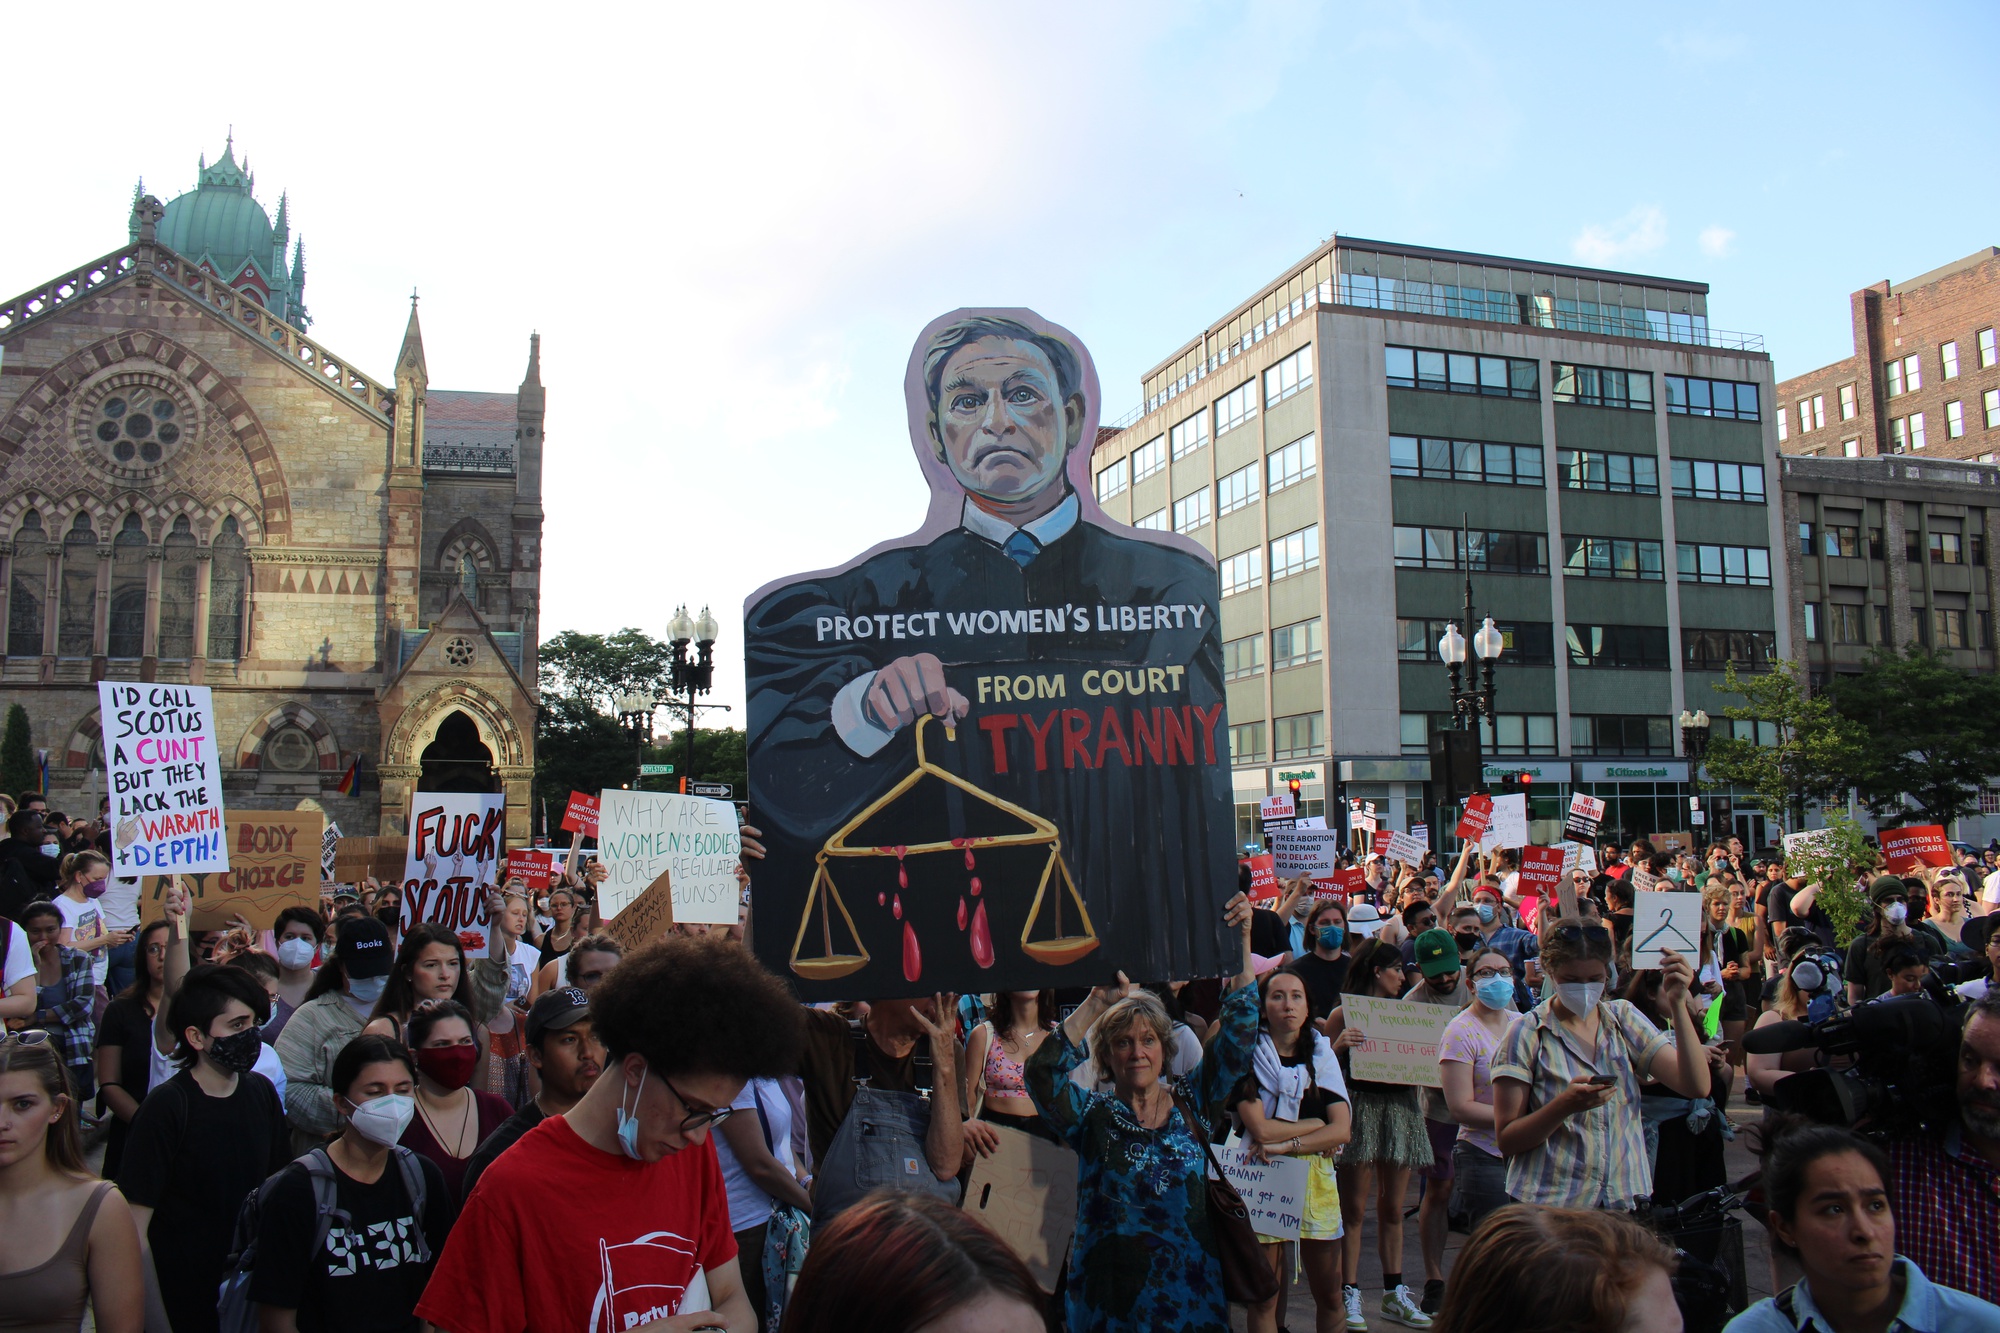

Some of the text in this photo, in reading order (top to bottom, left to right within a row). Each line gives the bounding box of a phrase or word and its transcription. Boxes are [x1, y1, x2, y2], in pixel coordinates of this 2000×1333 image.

[816, 603, 1206, 641] PROTECT WOMEN'S LIBERTY
[977, 665, 1184, 703] FROM COURT
[112, 686, 196, 708] I'D CALL
[116, 708, 203, 739] SCOTUS
[979, 703, 1223, 774] TYRANNY
[113, 735, 206, 767] A CUNT
[113, 761, 206, 794] BUT THEY
[1614, 767, 1668, 777] Citizens Bank
[119, 786, 209, 817] LACK THE
[569, 802, 600, 817] ABORTION
[1271, 796, 1283, 806] WE
[1583, 796, 1594, 807] WE
[567, 811, 600, 826] HEALTHCA
[612, 796, 720, 828] WHY ARE
[1263, 806, 1293, 817] DEMAND
[1571, 802, 1601, 819] DEMAND
[139, 806, 220, 843] WARMTH
[324, 826, 335, 838] THE
[236, 823, 299, 854] BODY
[415, 805, 503, 864] FUCK
[1276, 834, 1295, 842] FREE
[1296, 834, 1335, 843] ABORTION
[1405, 836, 1426, 849] ABORTION
[1886, 835, 1942, 850] ABORTION IS
[133, 831, 218, 867] DEPTH!
[601, 831, 740, 860] WOMEN'S BODIES
[1289, 844, 1322, 852] DEMAND
[1399, 840, 1418, 850] DEMAND
[1889, 844, 1945, 859] HEALTHCARE
[510, 860, 540, 870] ABORTION
[1276, 852, 1319, 861] NO DELAYS.
[509, 868, 547, 878] HEALTHCARE
[602, 856, 739, 886] MORE REGULATED
[1265, 867, 1273, 875] IS
[1289, 862, 1330, 870] APOLOGIES.
[1523, 861, 1560, 872] ABORTION IS
[218, 862, 306, 893] CHOICE
[1250, 876, 1274, 888] HCARE
[1522, 872, 1559, 883] HEALTHCARE
[1635, 871, 1648, 880] FREE
[670, 883, 731, 906] GUNS?!
[1312, 881, 1344, 892] HEALTH
[399, 876, 492, 938] SCOTUS
[608, 886, 656, 936] HAT ABOUT
[624, 900, 668, 953] RTBEAT?
[356, 939, 383, 950] Books
[565, 988, 588, 1005] B
[1367, 1000, 1388, 1012] you
[1396, 1003, 1417, 1013] can
[1427, 1006, 1443, 1016] cut
[1349, 1010, 1435, 1029] my reproductive
[1382, 1041, 1390, 1053] I
[1397, 1043, 1416, 1055] cut
[1221, 1148, 1232, 1160] If
[1235, 1152, 1257, 1166] MN
[1234, 1187, 1253, 1198] ould
[1257, 1190, 1275, 1205] get
[1251, 1208, 1300, 1230] at an ATM
[326, 1215, 421, 1277] 9:30
[623, 1304, 669, 1331] Party
